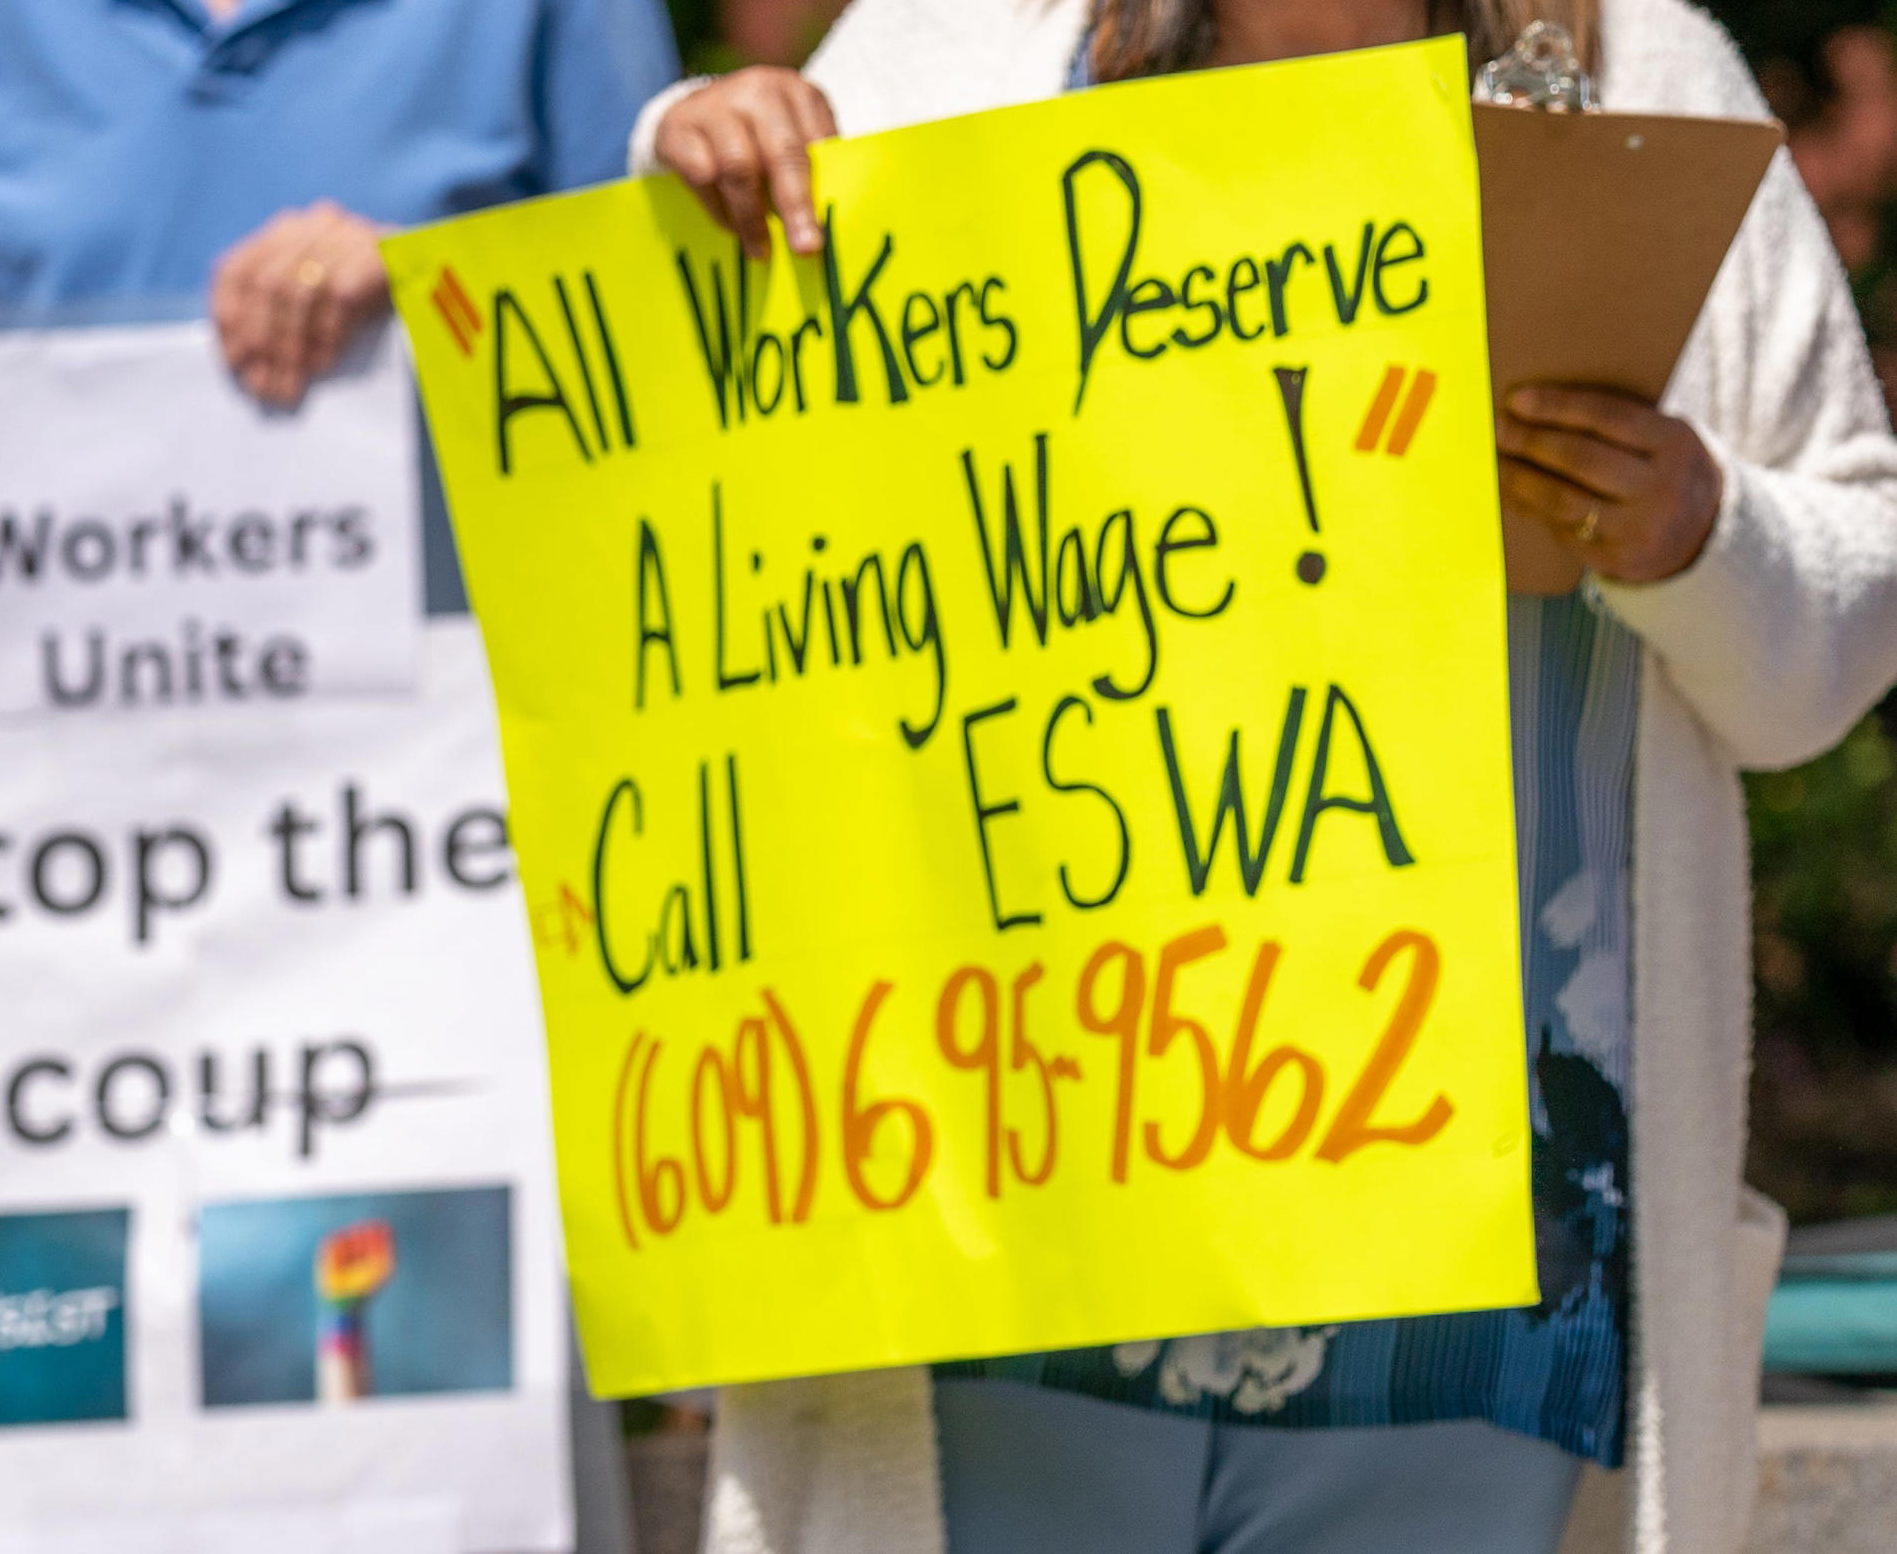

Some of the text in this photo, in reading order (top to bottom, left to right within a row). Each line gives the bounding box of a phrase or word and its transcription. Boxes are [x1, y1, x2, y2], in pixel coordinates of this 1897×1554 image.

[1062, 148, 1429, 414] Deserve
[40, 620, 314, 709] Unite
[637, 519, 682, 711] A
[711, 481, 947, 749] Living
[268, 779, 516, 905] the
[593, 755, 753, 994] Call
[2, 1038, 376, 1161] coup
[613, 988, 819, 1250] (609)
